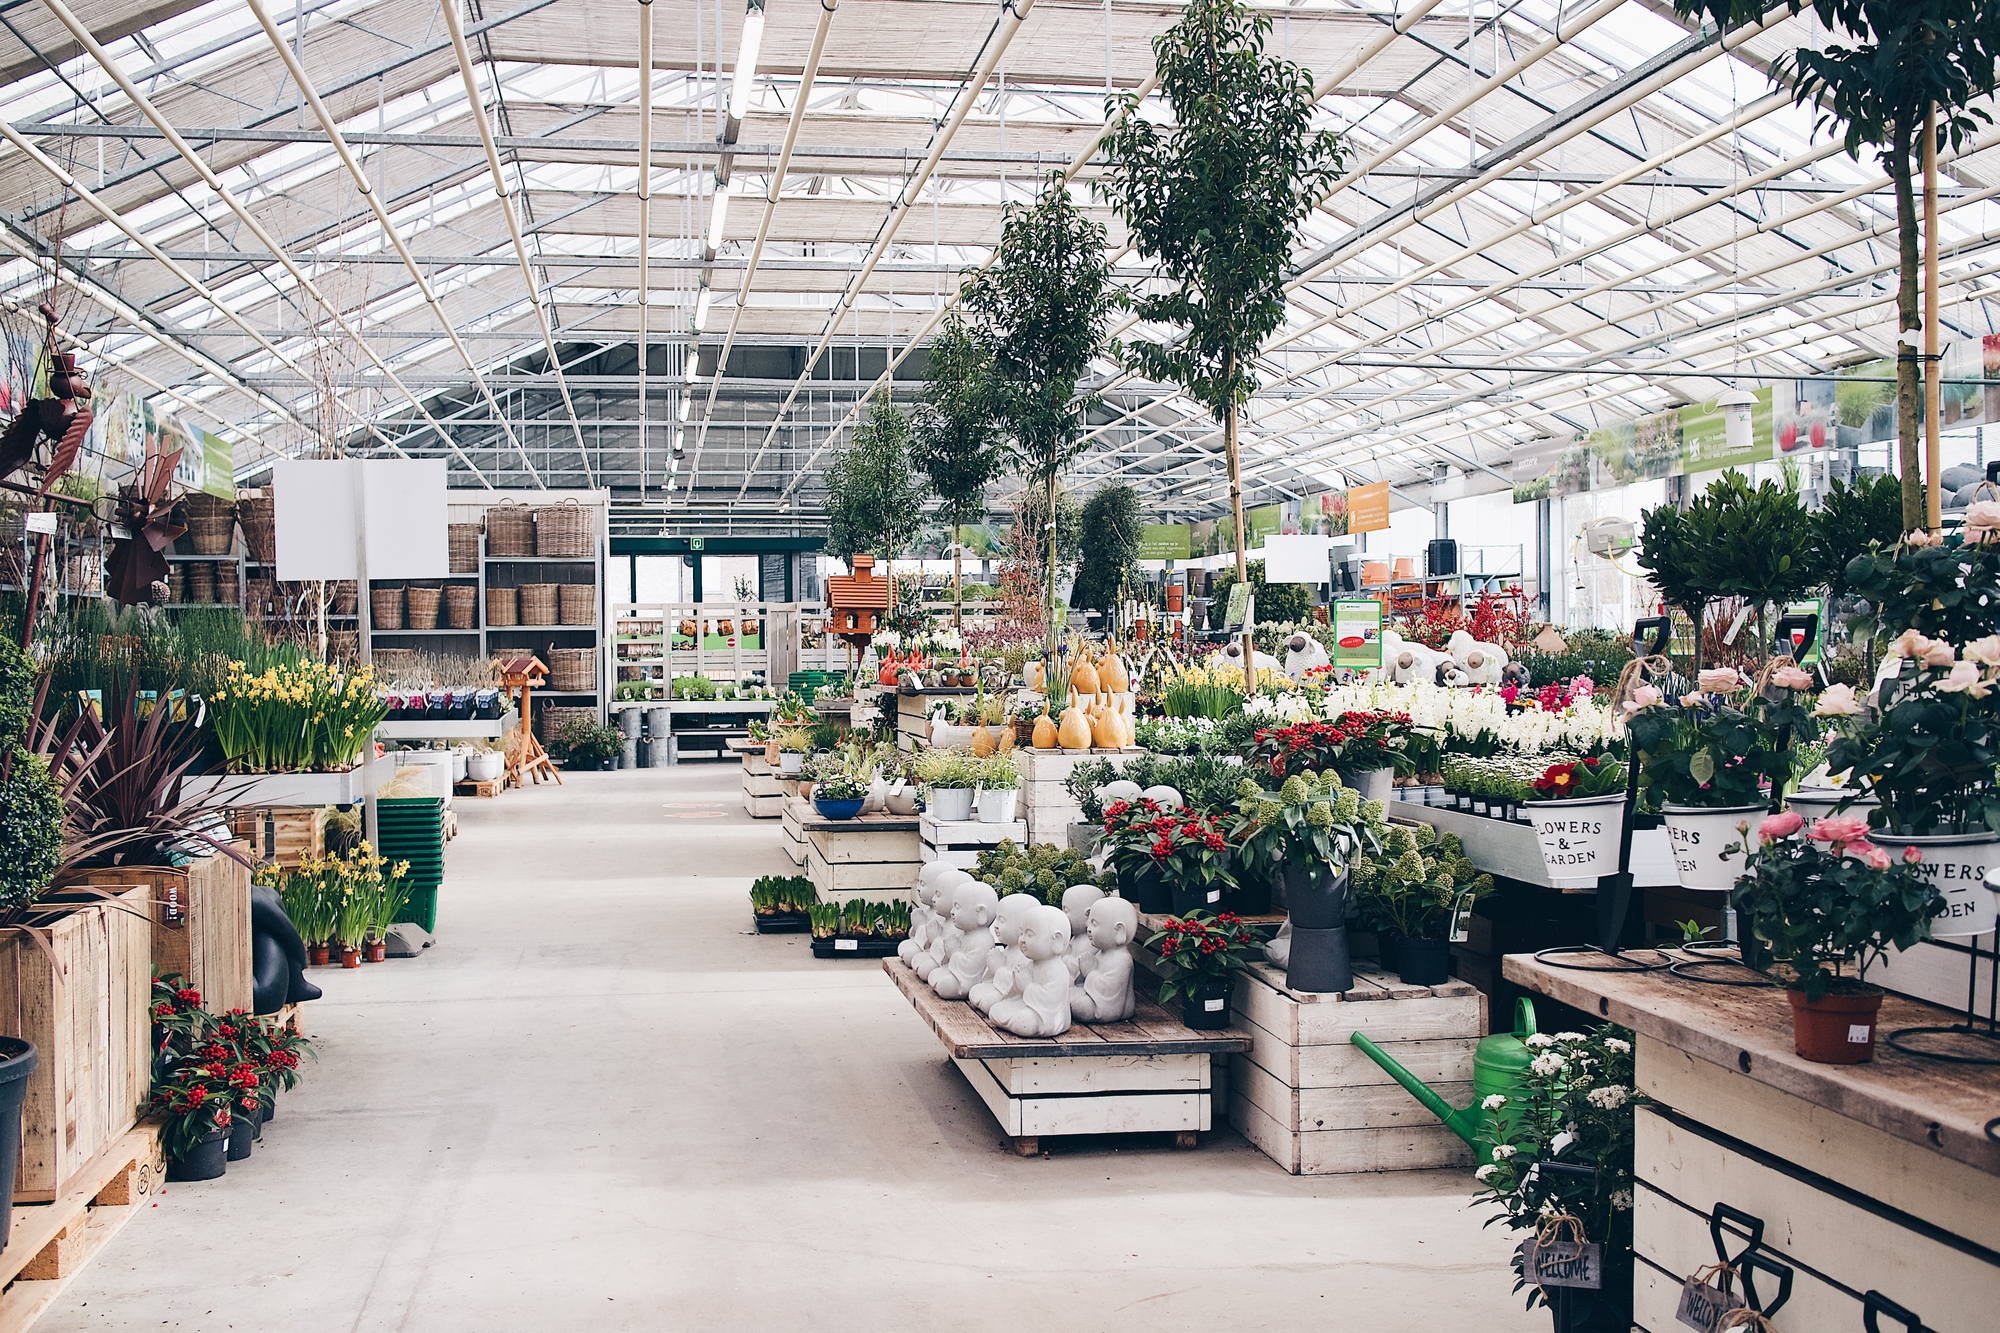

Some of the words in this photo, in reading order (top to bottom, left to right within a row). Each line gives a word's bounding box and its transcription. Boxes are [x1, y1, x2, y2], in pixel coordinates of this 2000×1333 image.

[1558, 837, 1570, 850] &
[1544, 850, 1596, 865] GARDEN
[1676, 859, 1697, 872] DEN
[1911, 863, 1986, 881] OWERS
[169, 886, 178, 920] WOOD!
[1937, 901, 1975, 919] DEN
[1536, 1252, 1591, 1282] WELCOME
